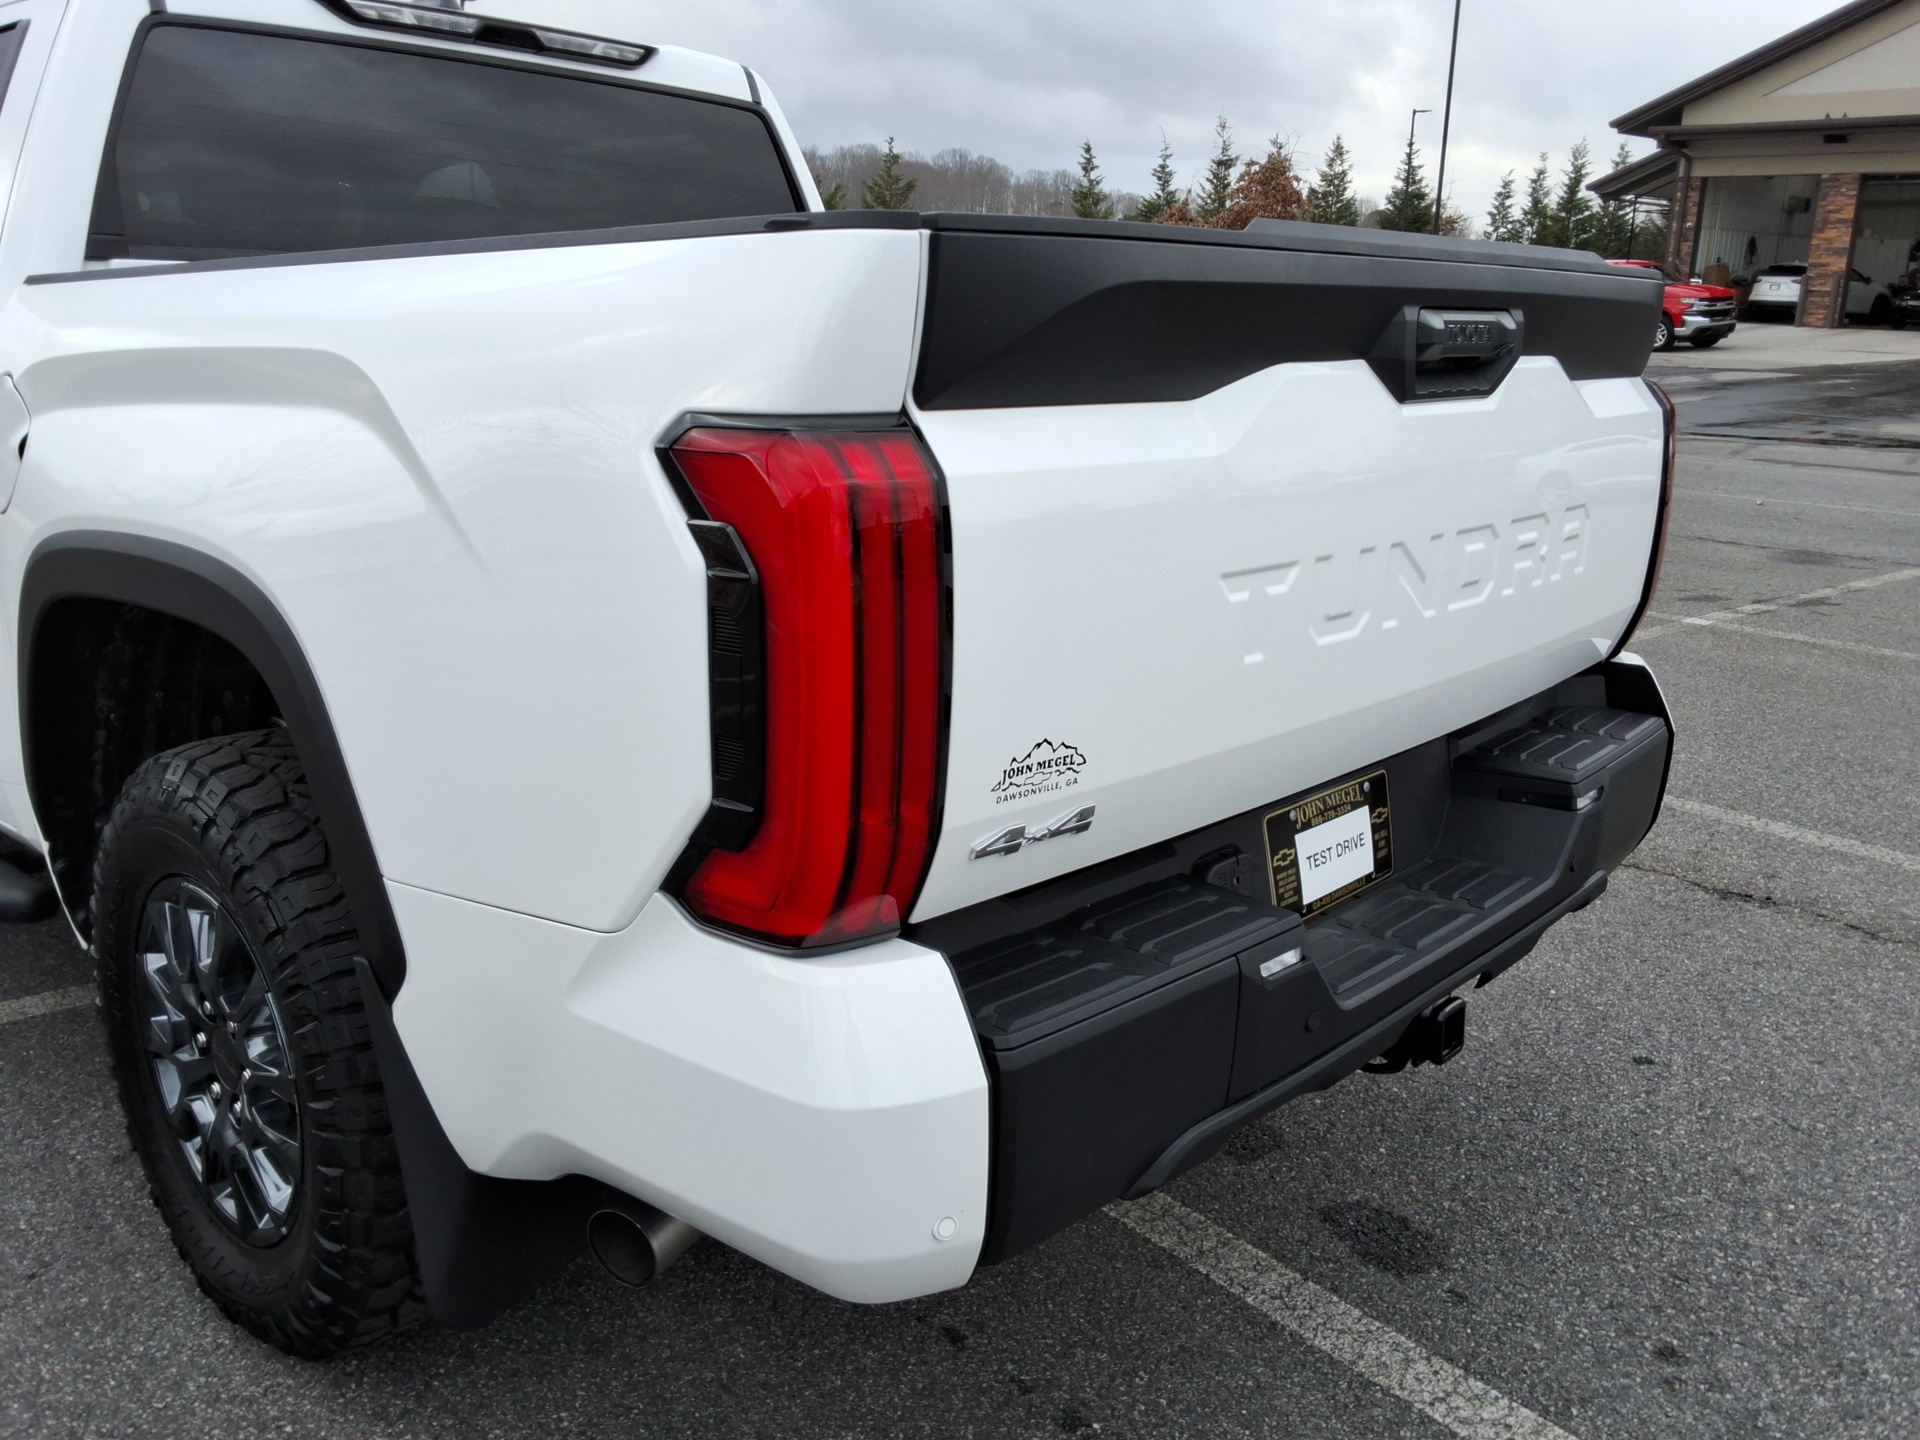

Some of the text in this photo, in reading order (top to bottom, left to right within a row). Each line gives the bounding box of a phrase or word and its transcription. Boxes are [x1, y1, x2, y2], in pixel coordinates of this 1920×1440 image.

[1218, 502, 1590, 666] TUNDRA
[1001, 754, 1076, 786] JOHN MEGEL
[996, 777, 1078, 804] DAWSONVILLE, GA
[1296, 783, 1364, 830] JOHN MEGEL
[1306, 846, 1333, 870] TEST
[1335, 832, 1366, 858] DRIVE
